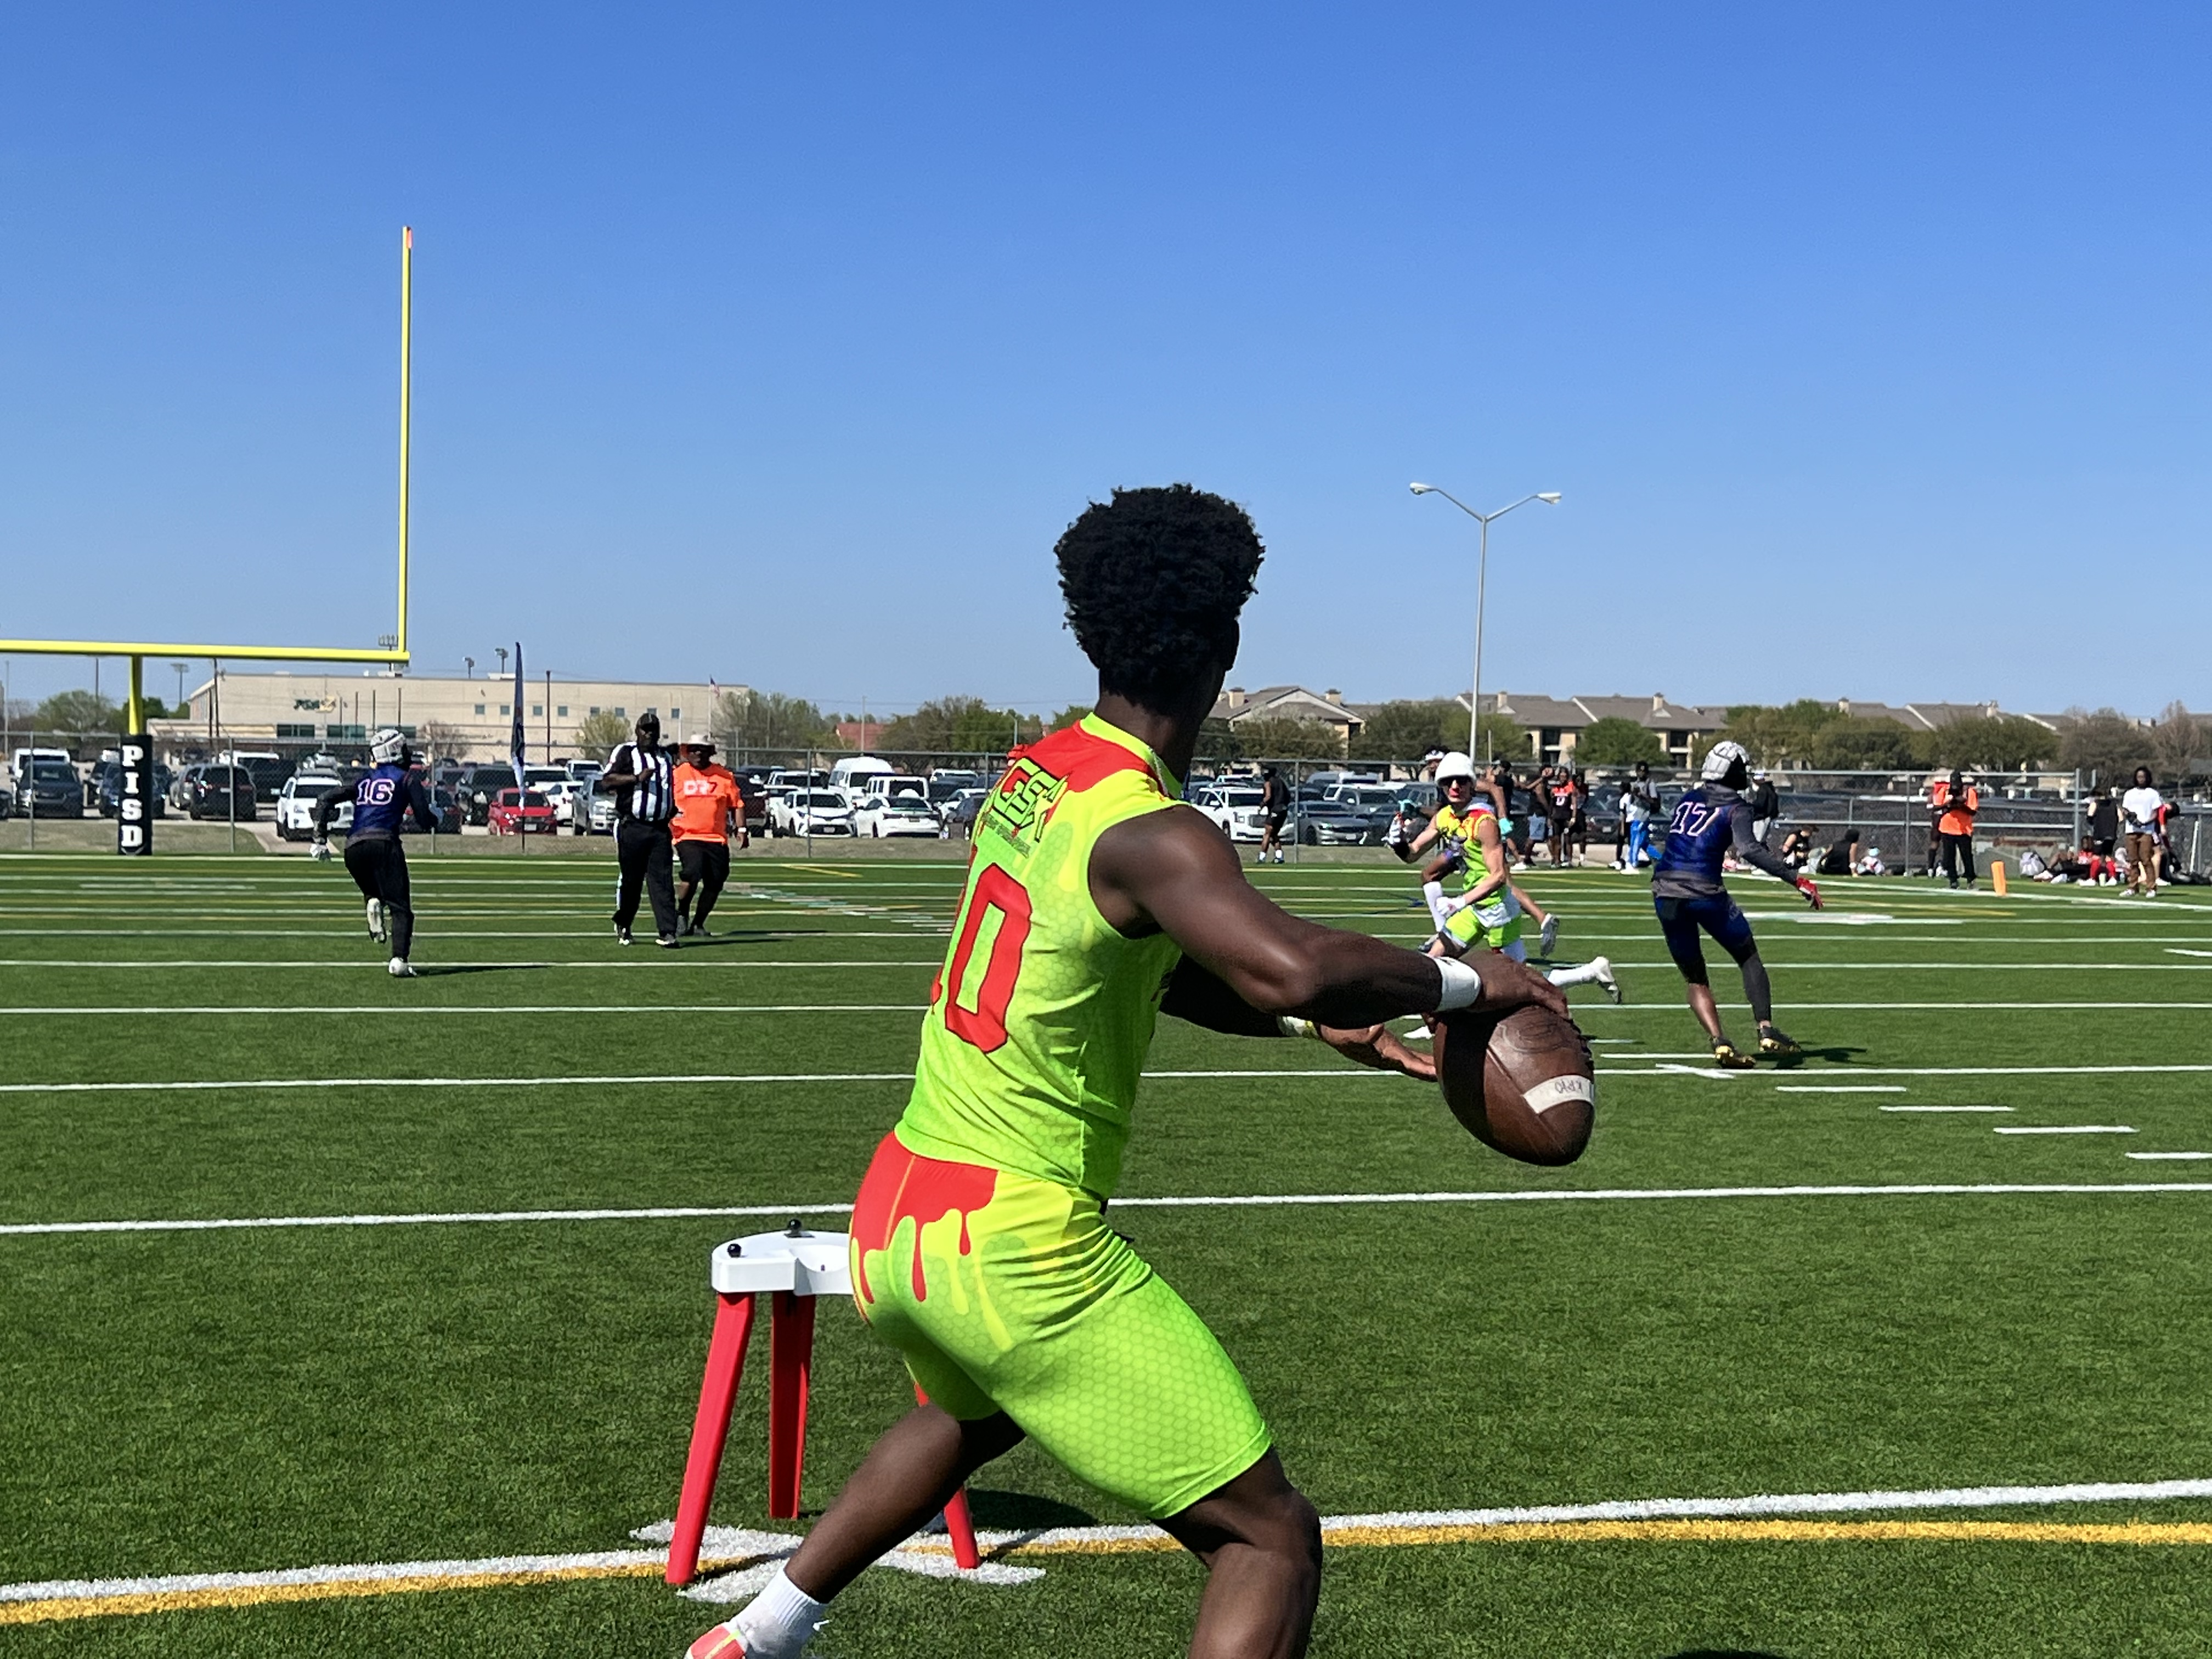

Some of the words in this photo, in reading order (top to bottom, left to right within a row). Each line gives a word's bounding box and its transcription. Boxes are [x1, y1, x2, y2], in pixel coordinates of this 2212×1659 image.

[121, 745, 144, 847] PISD
[356, 778, 395, 805] 16
[1669, 802, 1720, 836] 17
